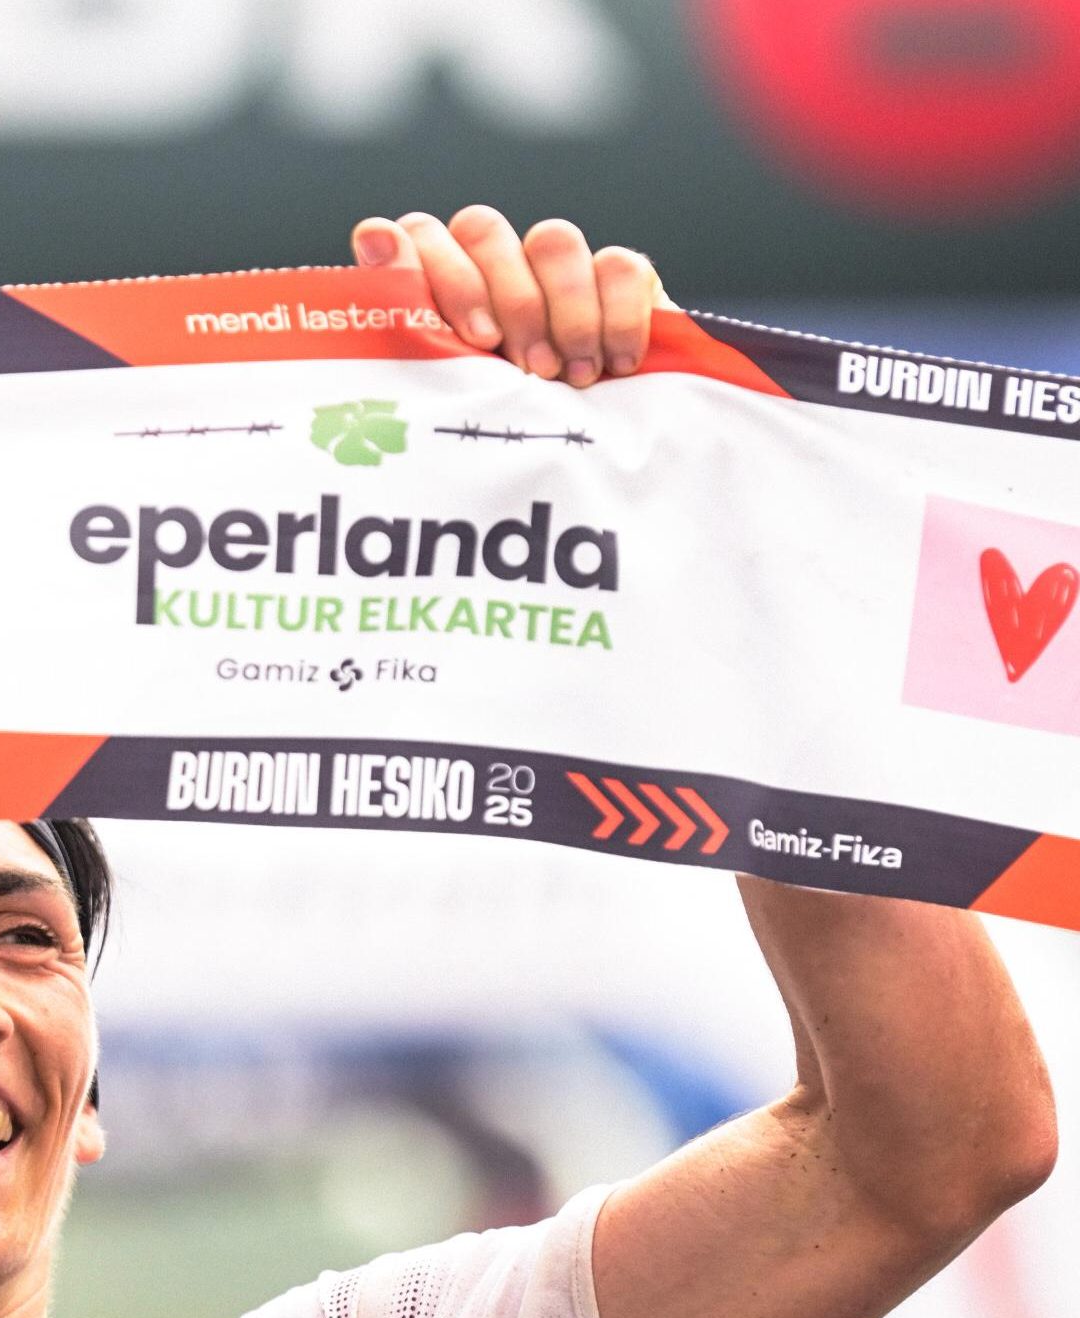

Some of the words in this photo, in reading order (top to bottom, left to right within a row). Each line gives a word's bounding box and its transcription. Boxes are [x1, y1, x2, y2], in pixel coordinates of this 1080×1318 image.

[184, 302, 292, 334] mendi
[296, 302, 453, 331] lasterke
[837, 351, 994, 412] BURDIN
[69, 494, 620, 625] eperlanda
[153, 589, 344, 632] KULTUR
[358, 596, 614, 651] ELKARTEA
[216, 658, 319, 684] Gamiz
[376, 659, 438, 684] Fika
[166, 751, 321, 817] BURDIN
[330, 754, 476, 822] HESIKO
[487, 762, 536, 796] 20
[483, 794, 534, 828] 25
[749, 818, 904, 870] Gamiz-Fika
